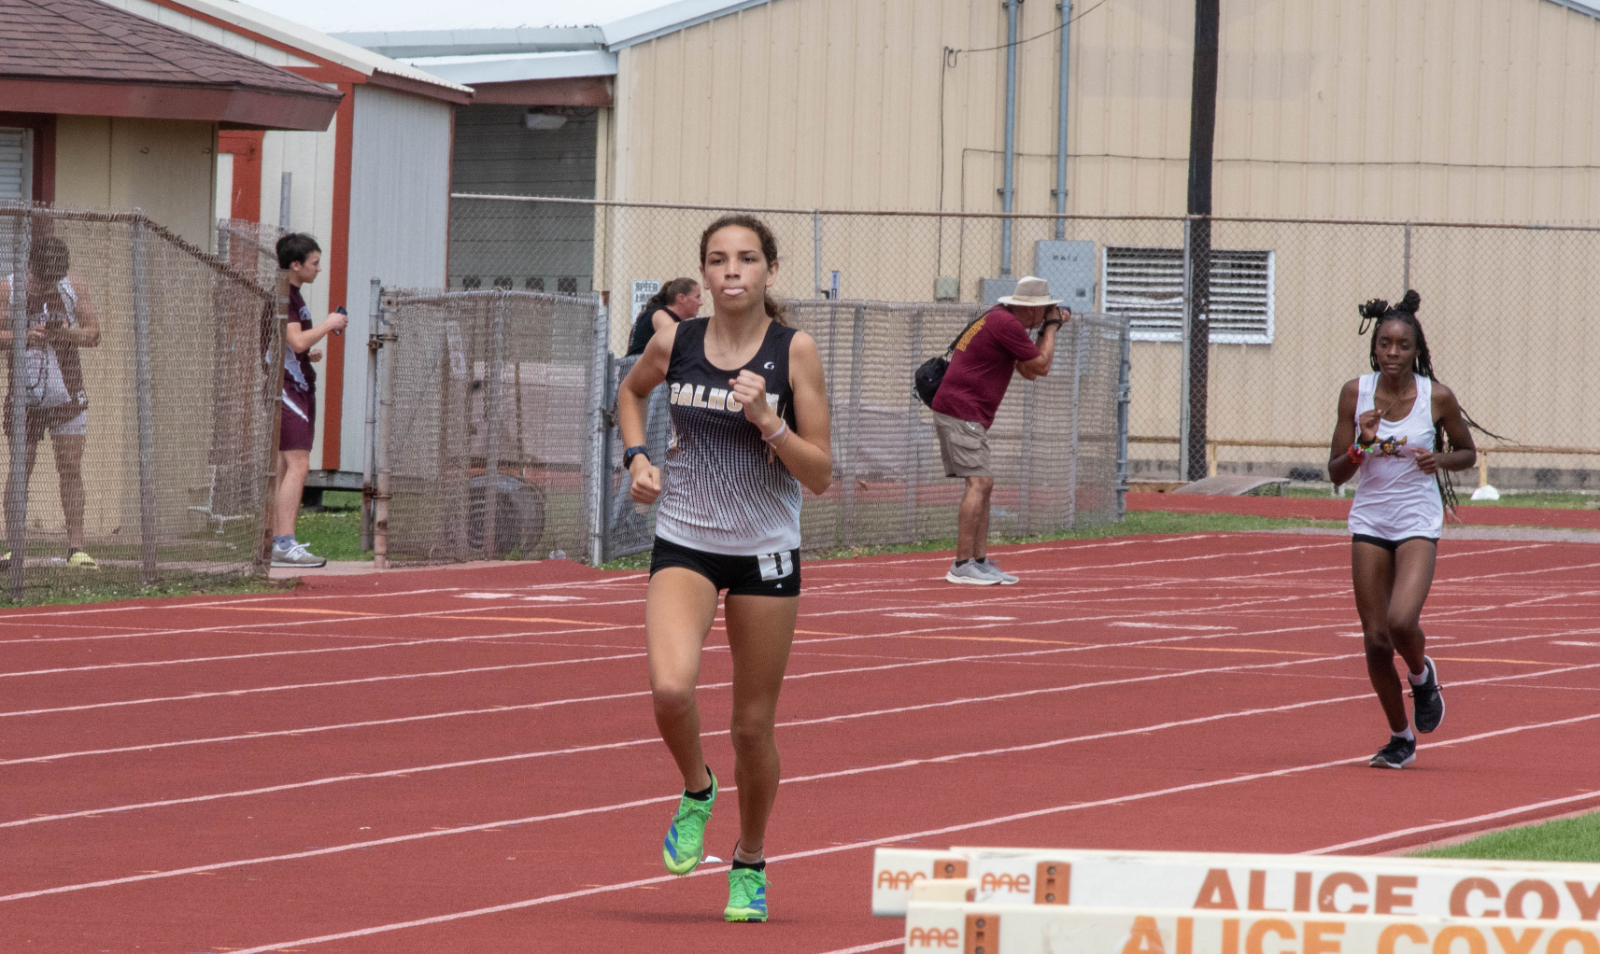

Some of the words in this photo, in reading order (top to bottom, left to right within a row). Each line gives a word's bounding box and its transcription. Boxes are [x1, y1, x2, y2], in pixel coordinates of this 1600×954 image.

[635, 282, 659, 292] SPEED
[670, 382, 780, 416] CALHON
[1193, 868, 1418, 915] ALICE
[1121, 915, 1346, 954] ALICE
